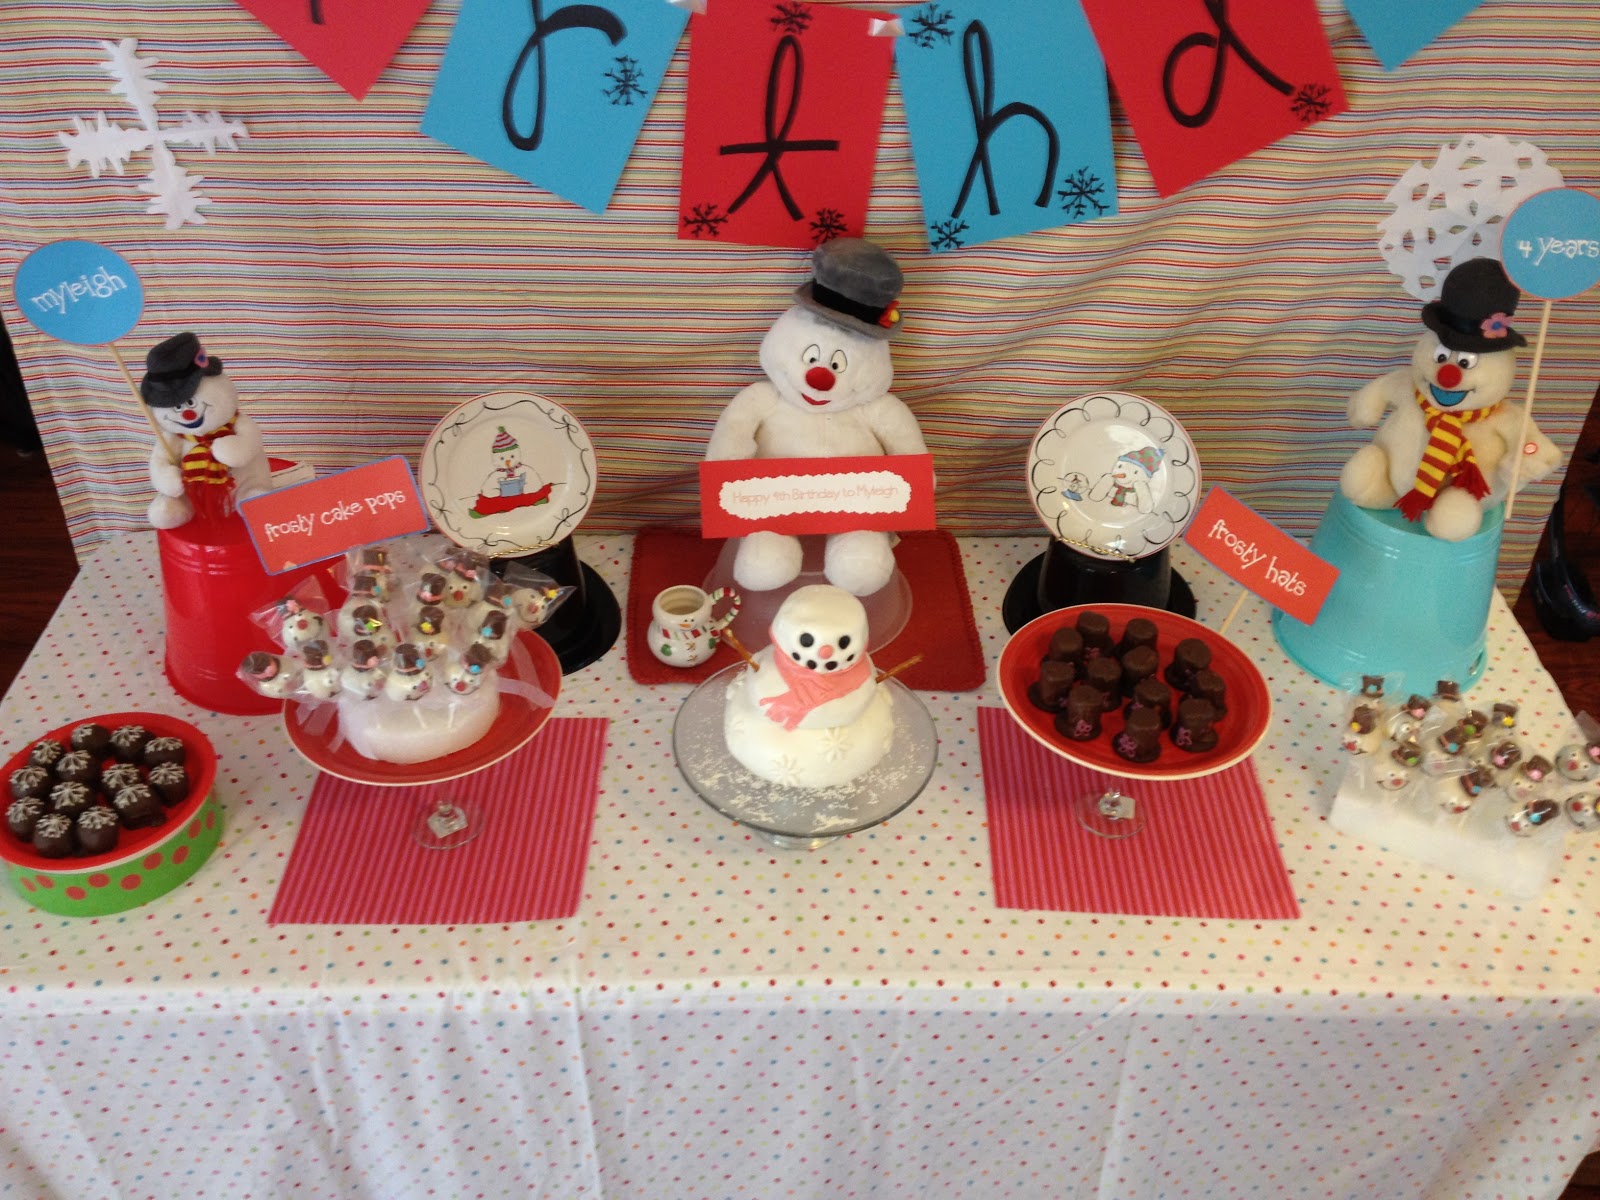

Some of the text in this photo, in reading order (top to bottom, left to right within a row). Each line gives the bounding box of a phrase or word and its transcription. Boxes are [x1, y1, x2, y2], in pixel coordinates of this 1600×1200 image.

[1517, 237, 1600, 266] 4 years
[31, 265, 128, 314] myleigh
[264, 490, 407, 542] frosty cake pops
[732, 483, 898, 507] Happy 4th Birthday to Myleigh
[1208, 518, 1308, 596] frosty hats
